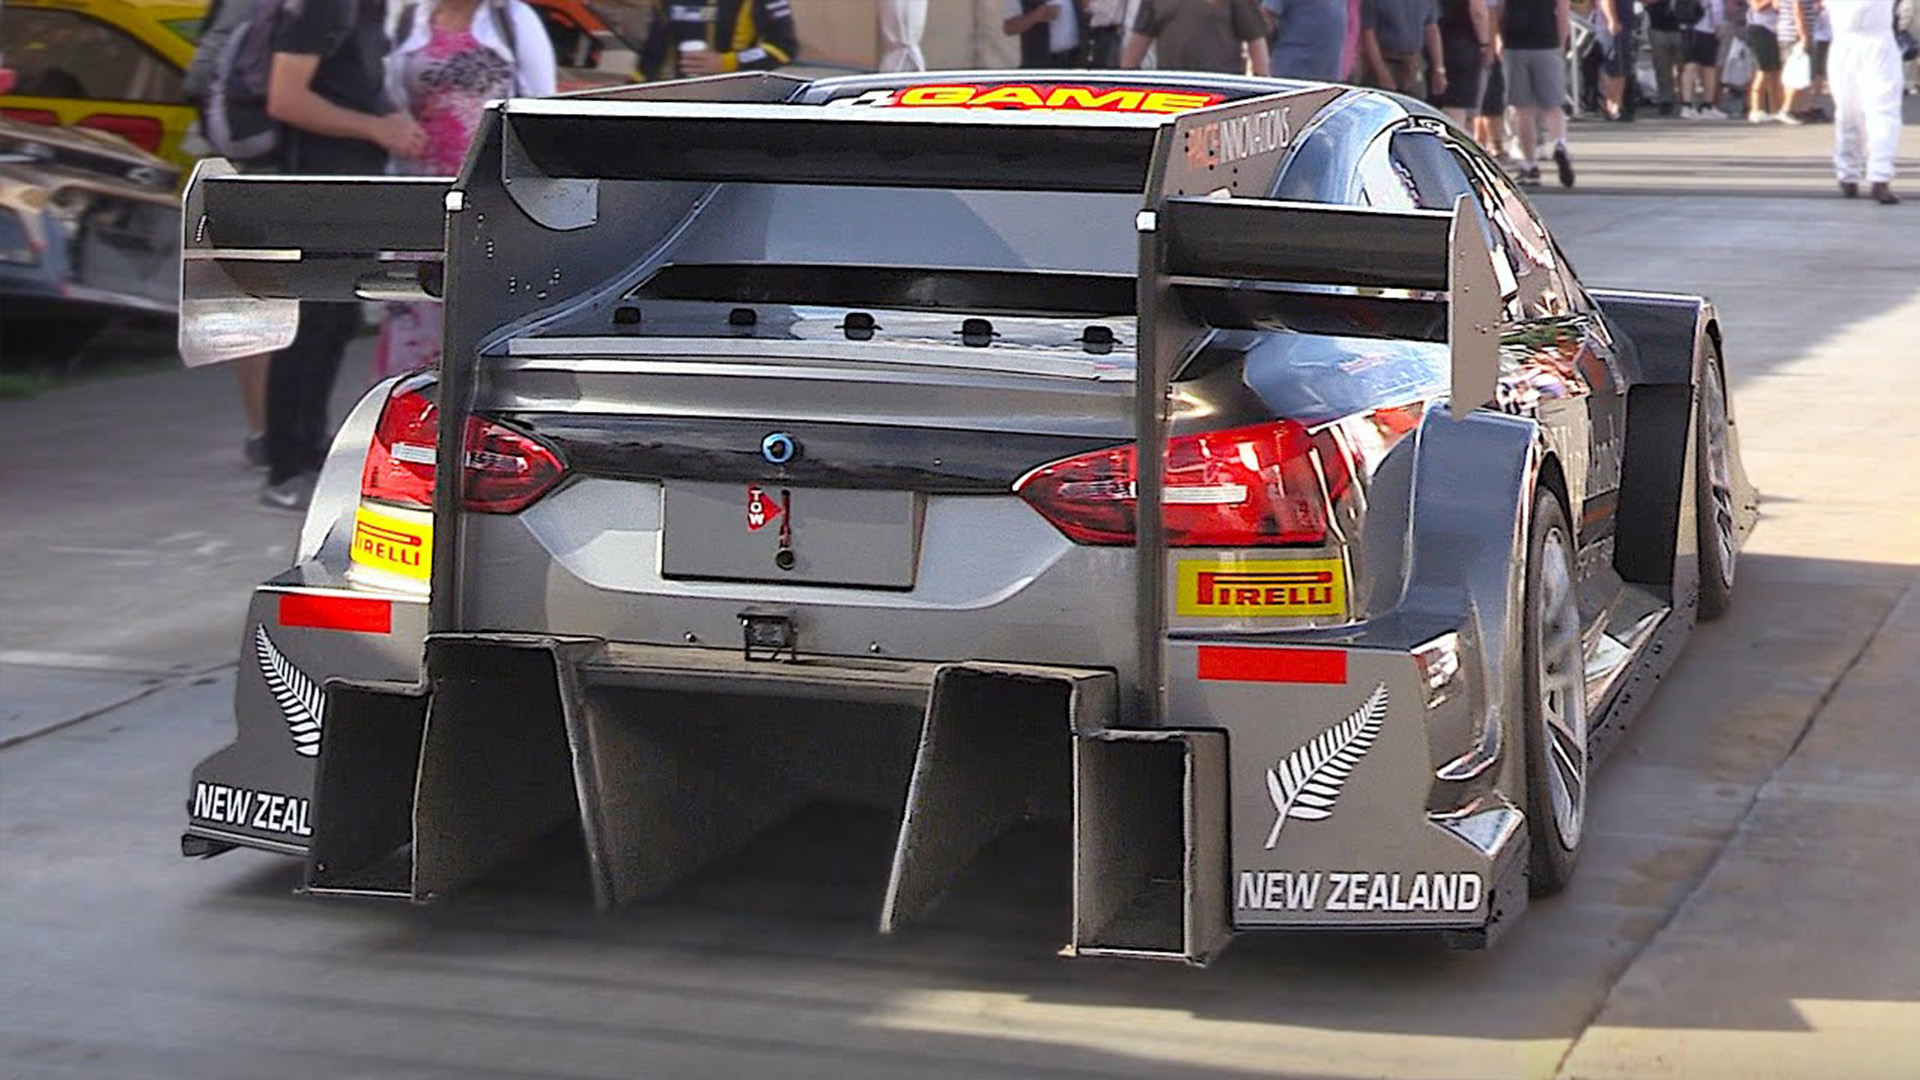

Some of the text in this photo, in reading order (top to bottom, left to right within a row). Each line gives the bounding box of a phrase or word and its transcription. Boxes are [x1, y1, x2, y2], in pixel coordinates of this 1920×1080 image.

[901, 86, 1210, 112] GAME
[748, 489, 765, 525] TOW
[355, 519, 422, 567] PIRELLI
[1197, 571, 1333, 605] PIRELLI
[194, 783, 312, 836] NEW ZEAL
[1238, 871, 1483, 912] NEW ZEALAND
